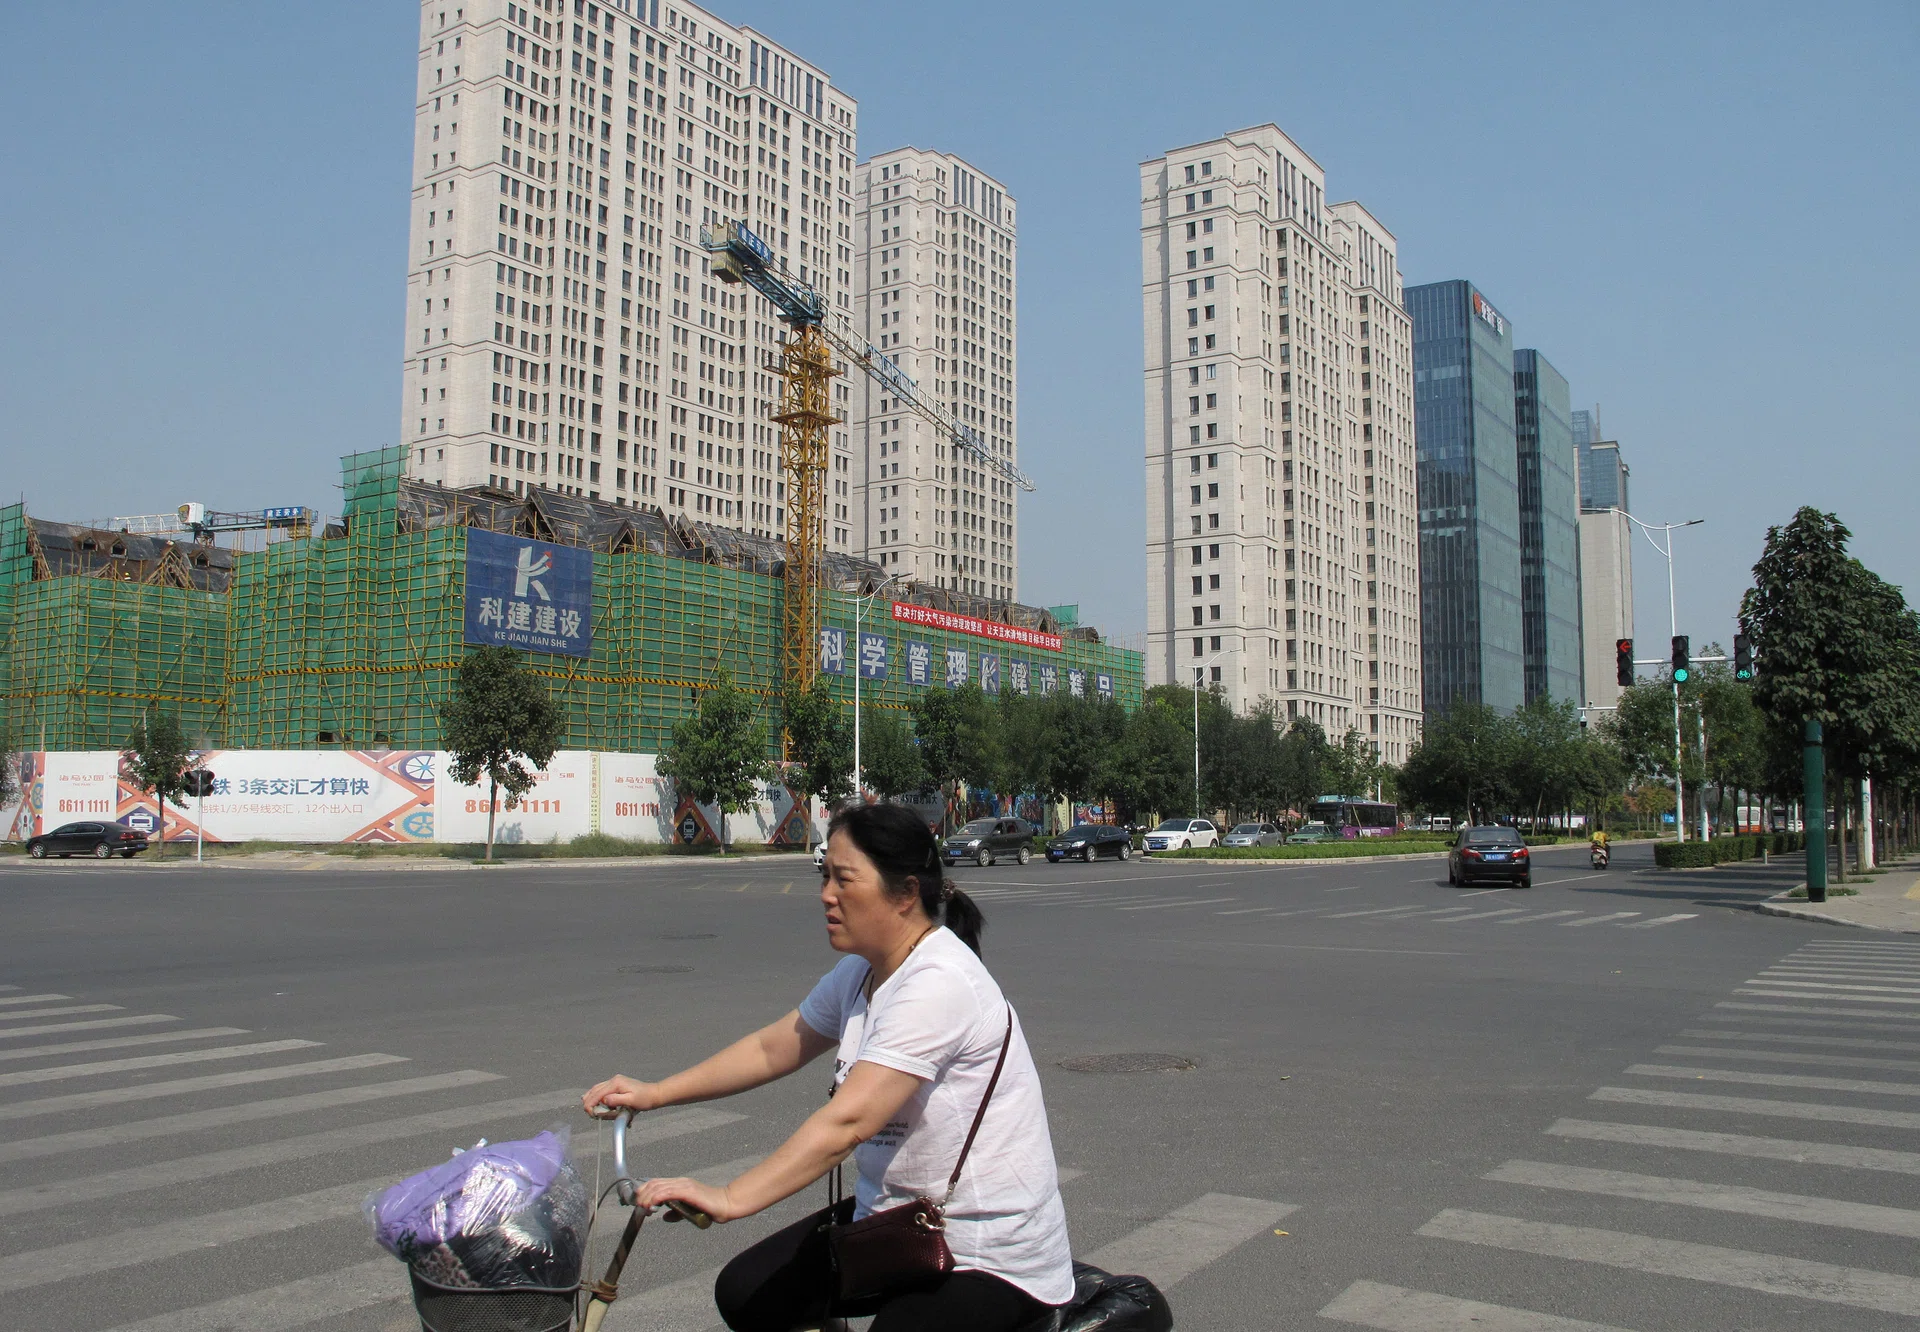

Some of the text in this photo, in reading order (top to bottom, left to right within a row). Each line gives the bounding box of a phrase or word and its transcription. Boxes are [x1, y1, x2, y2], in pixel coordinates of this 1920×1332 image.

[479, 597, 582, 639] 科建建设
[894, 604, 983, 634] 坚决打好大气污染治理攻坚战
[494, 631, 568, 648] KE JIAN JIAN SHE
[238, 777, 370, 796] 3条交汇才算快
[58, 799, 110, 813] 8611 1111
[615, 802, 660, 817] 8611 1111
